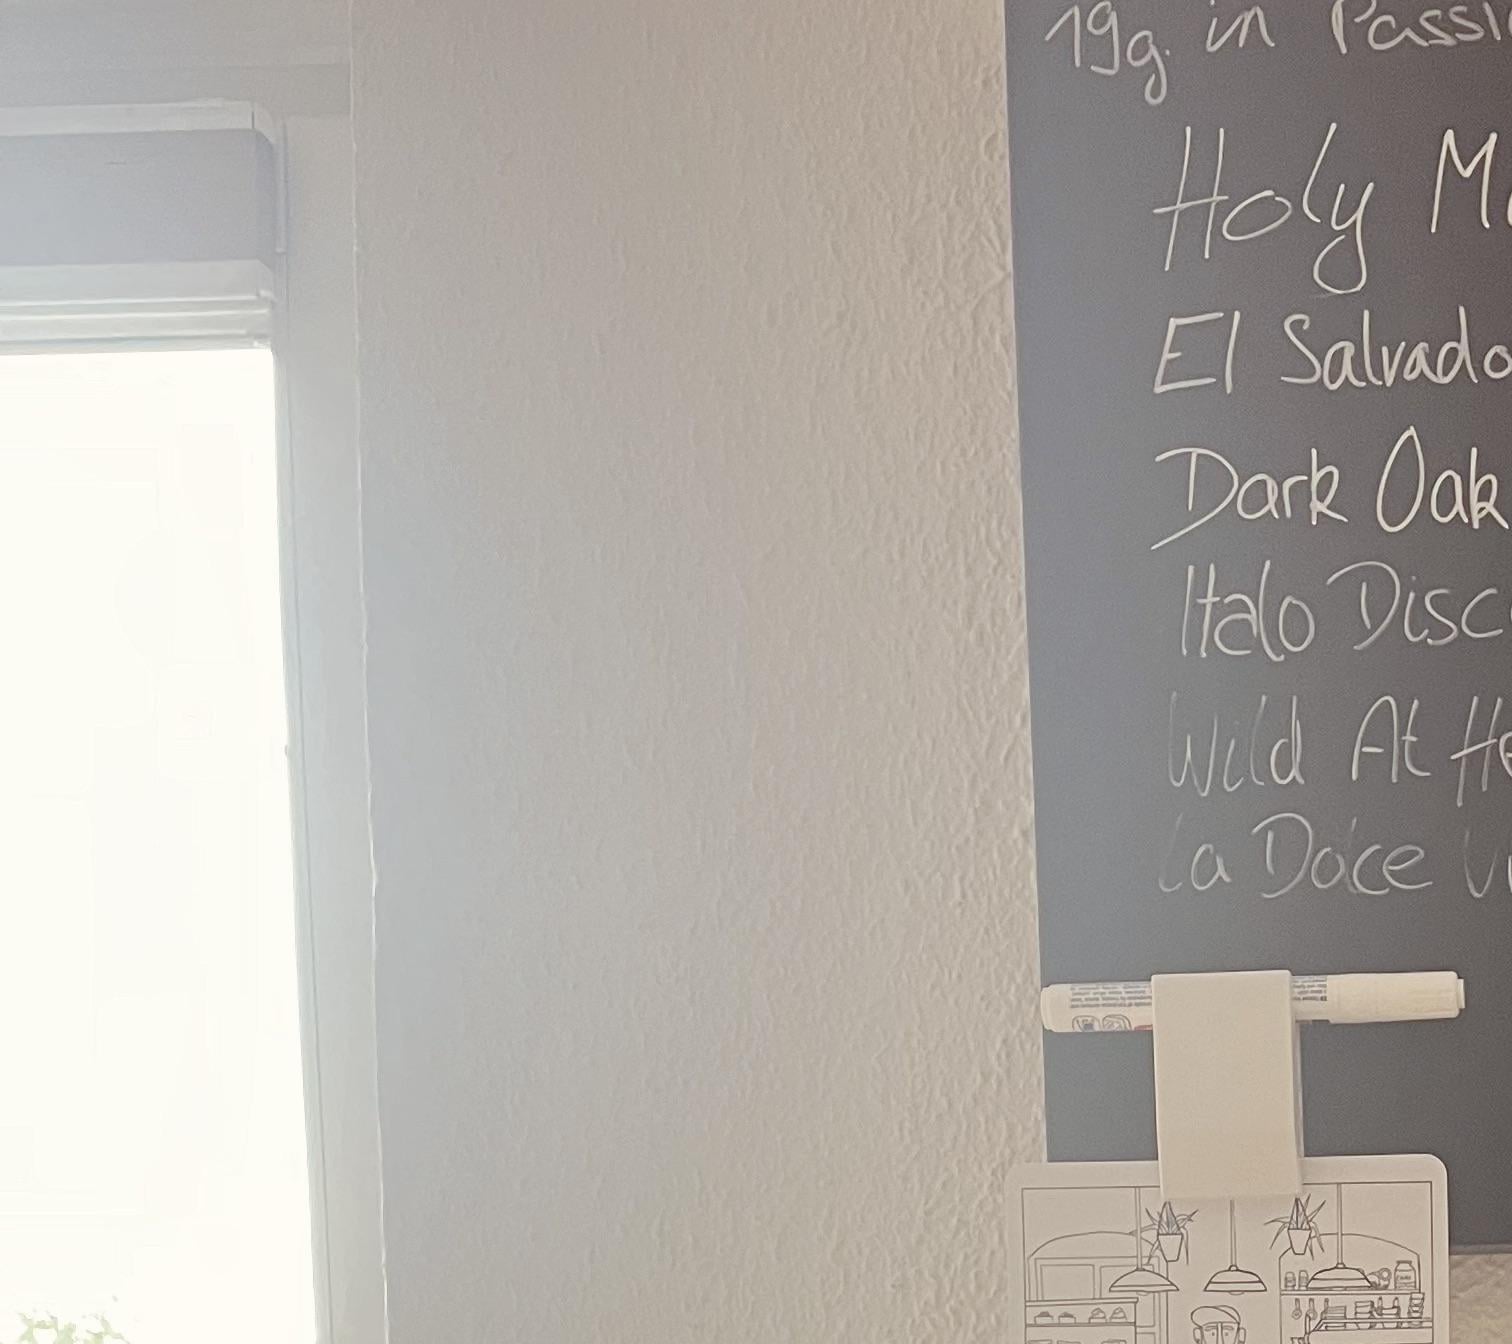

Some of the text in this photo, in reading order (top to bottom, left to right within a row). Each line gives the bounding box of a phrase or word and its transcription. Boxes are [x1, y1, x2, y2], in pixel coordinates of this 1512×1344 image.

[1205, 0, 1276, 53] in
[1153, 122, 1374, 295] Holy
[1153, 310, 1241, 395] El
[1150, 447, 1349, 550] Dark
[1375, 425, 1509, 533] Oak
[1181, 559, 1316, 662] Italo
[1166, 691, 1305, 797] Wild
[1351, 695, 1431, 784] At
